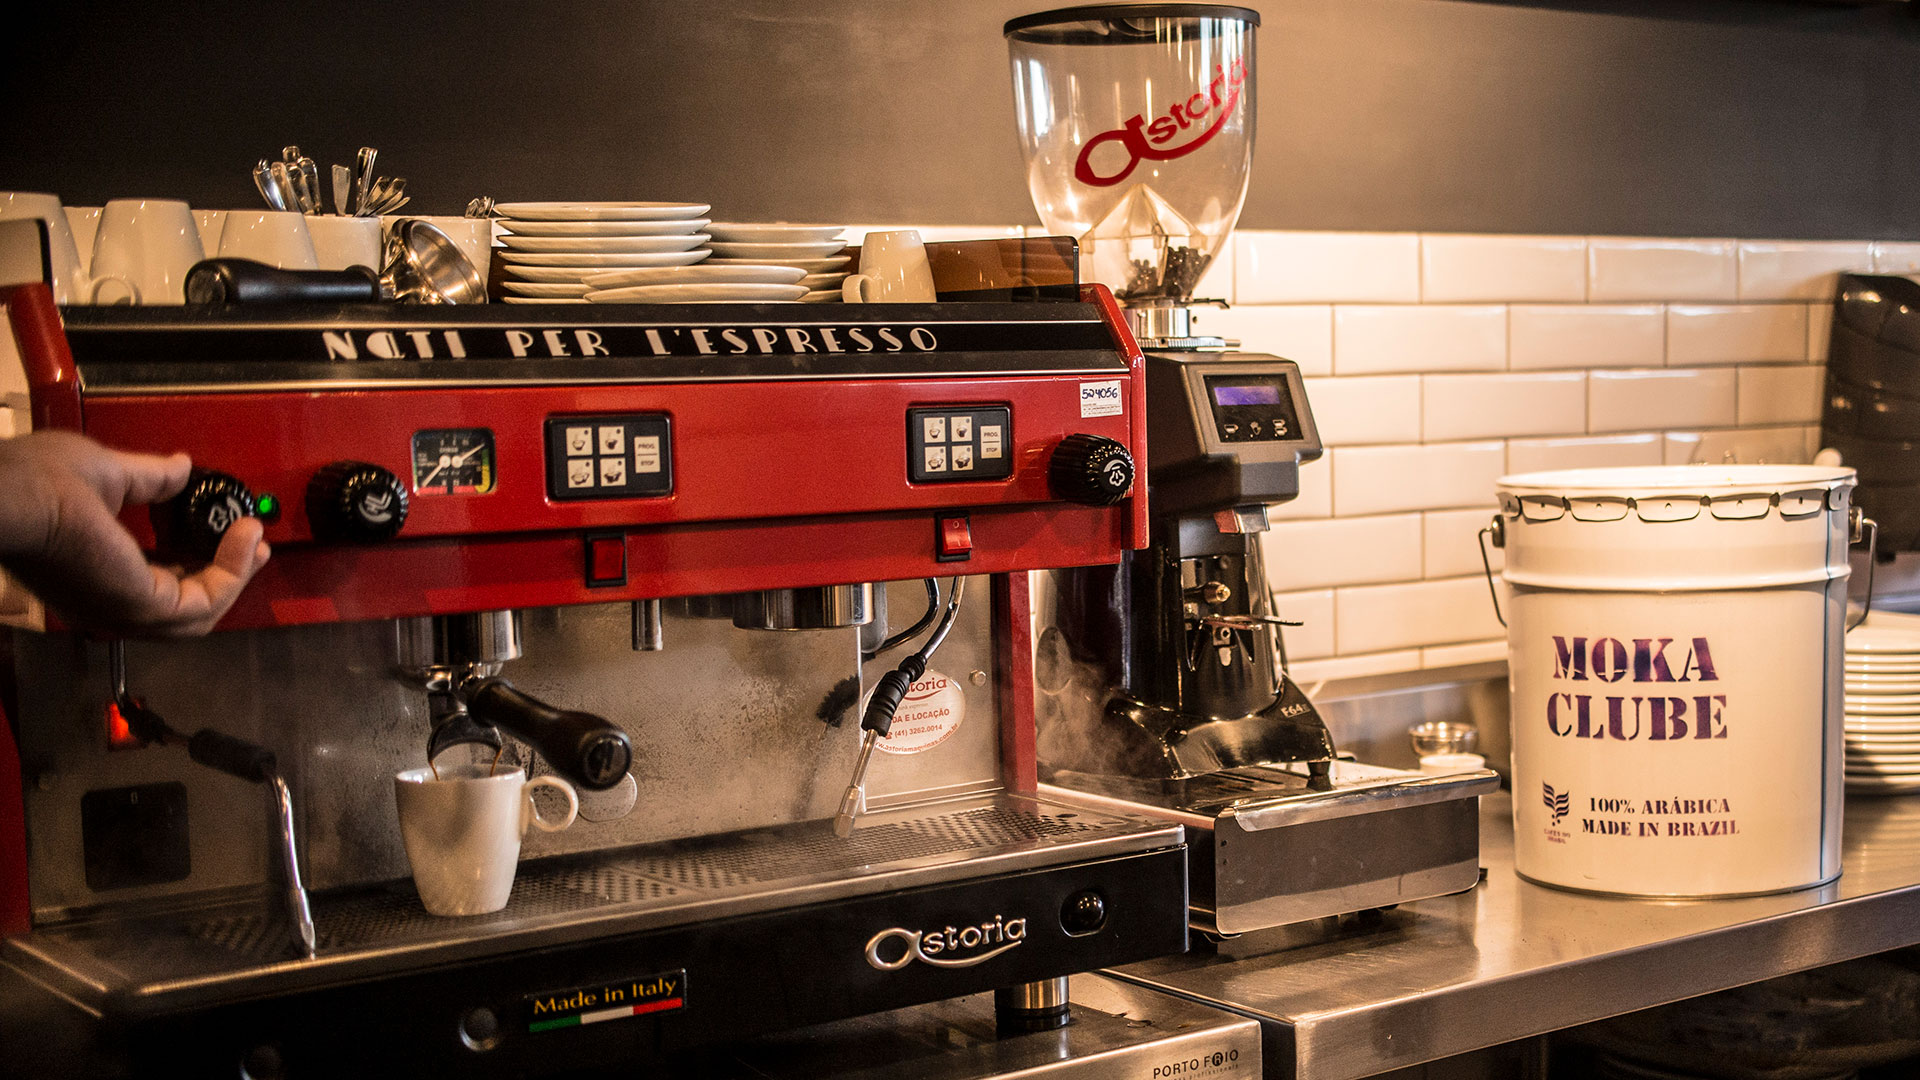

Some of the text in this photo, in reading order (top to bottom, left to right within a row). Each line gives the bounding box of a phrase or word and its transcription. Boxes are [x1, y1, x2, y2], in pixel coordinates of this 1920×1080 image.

[505, 329, 609, 358] PER
[644, 328, 938, 356] L'ESPRESSO
[1081, 386, 1118, 400] 524056
[1552, 635, 1720, 683] MOKA
[904, 677, 947, 695] toria
[905, 714, 910, 722] E
[912, 708, 950, 721] LOCAÇÃO
[1547, 692, 1728, 741] CLUBE
[894, 729, 908, 738] (41)
[1590, 796, 1731, 815] 100% ARÁBICA
[1582, 818, 1741, 837] MADE IN BRAZIL
[534, 978, 677, 1015] Made in Italy
[1153, 1049, 1239, 1080] PORTO FRIO
